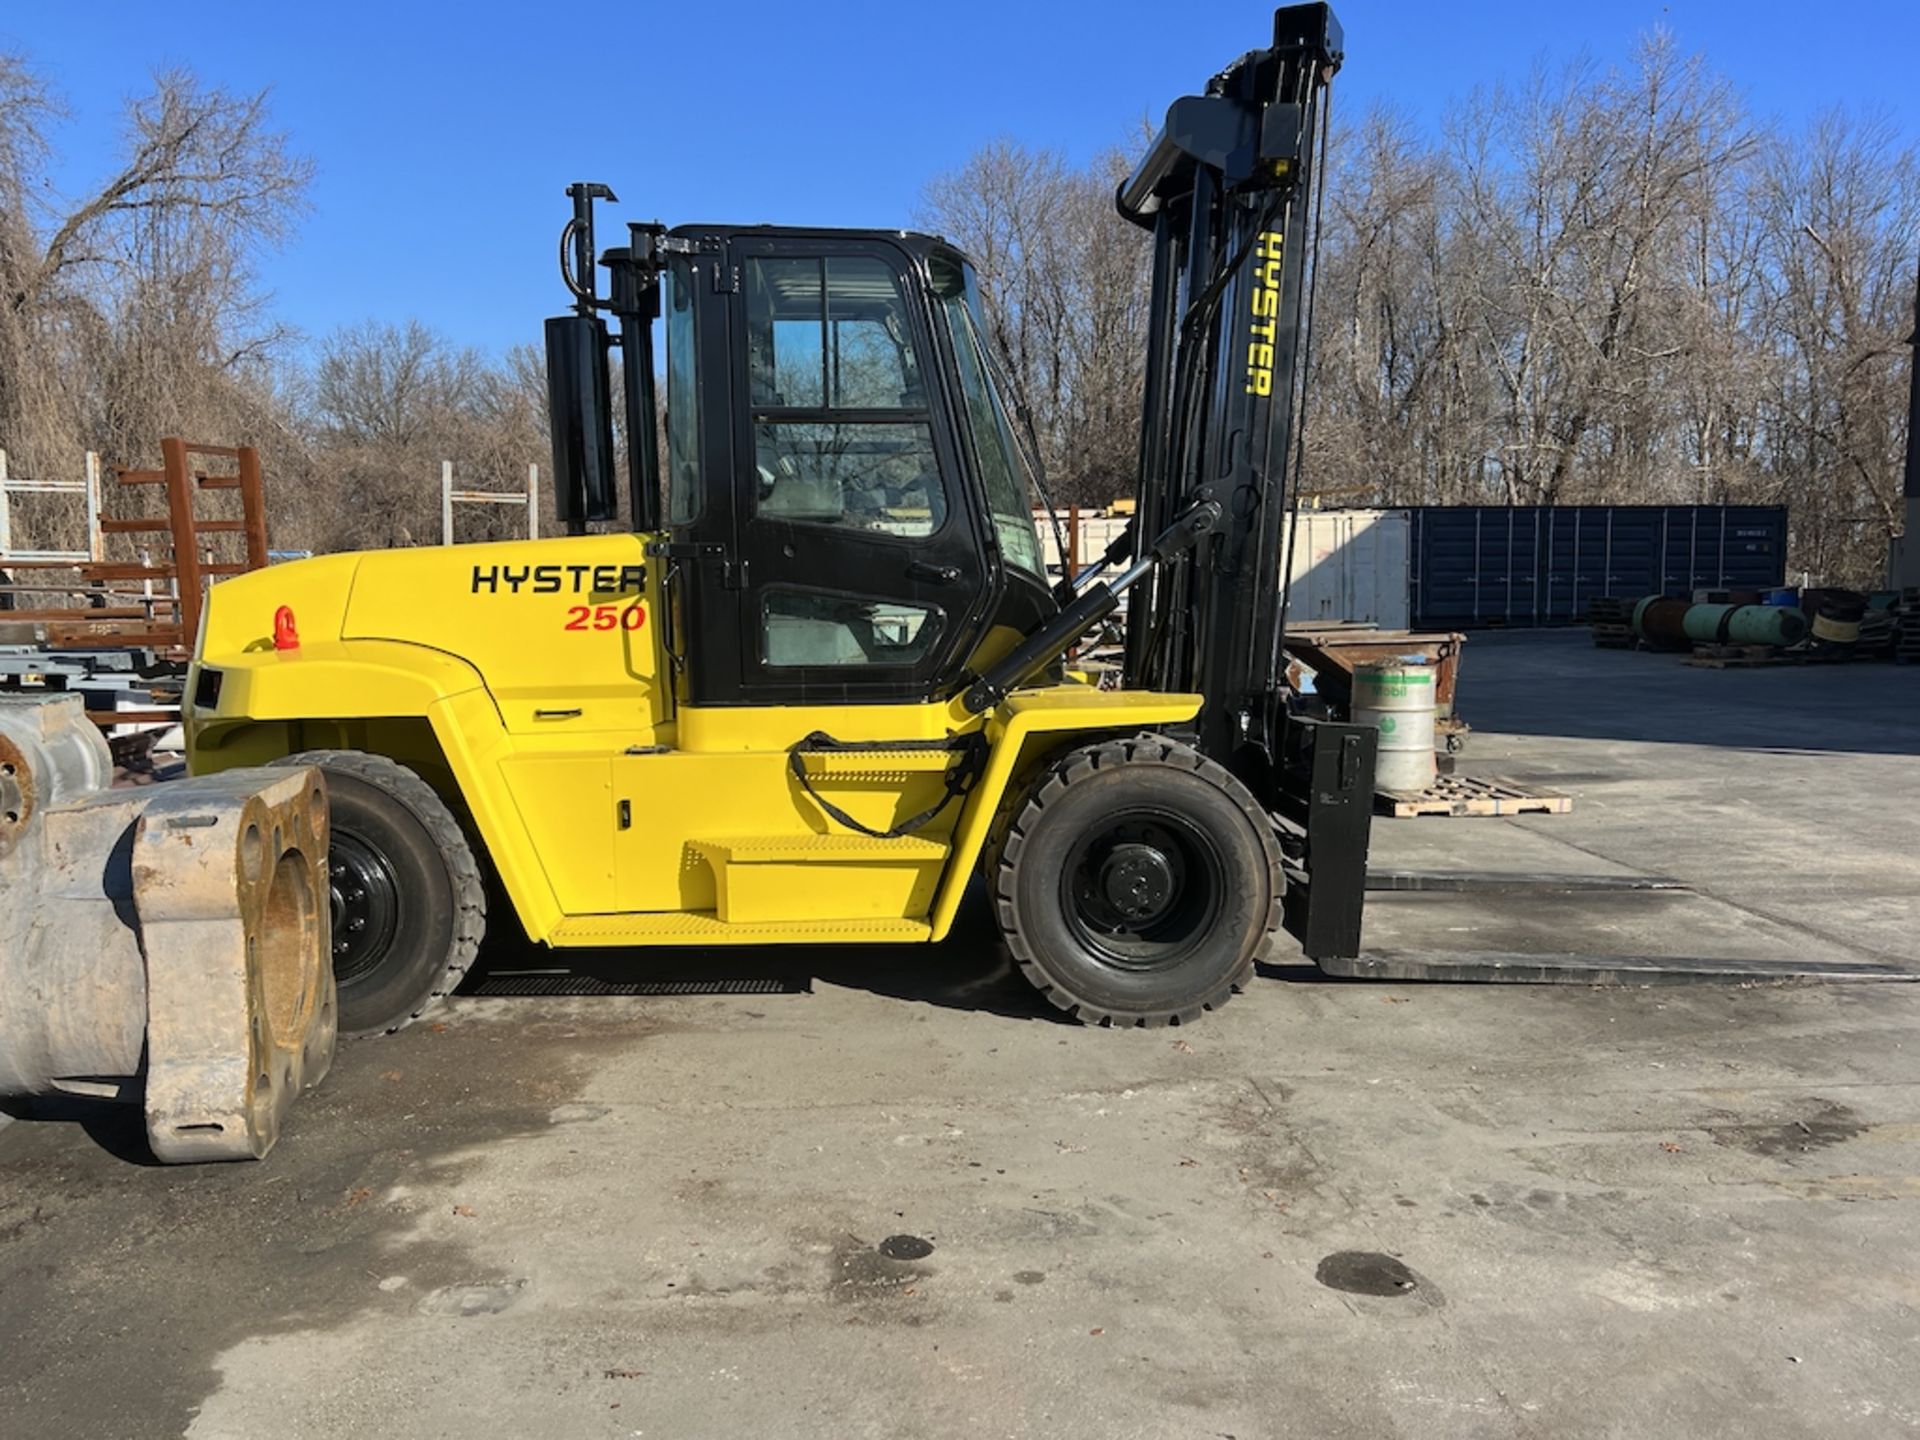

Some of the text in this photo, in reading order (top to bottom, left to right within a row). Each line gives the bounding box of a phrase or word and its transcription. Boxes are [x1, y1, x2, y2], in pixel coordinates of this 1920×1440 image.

[1246, 232, 1283, 396] HYSTER
[471, 565, 647, 593] HYSTER
[564, 605, 646, 631] 250
[1371, 685, 1407, 697] Mobil
